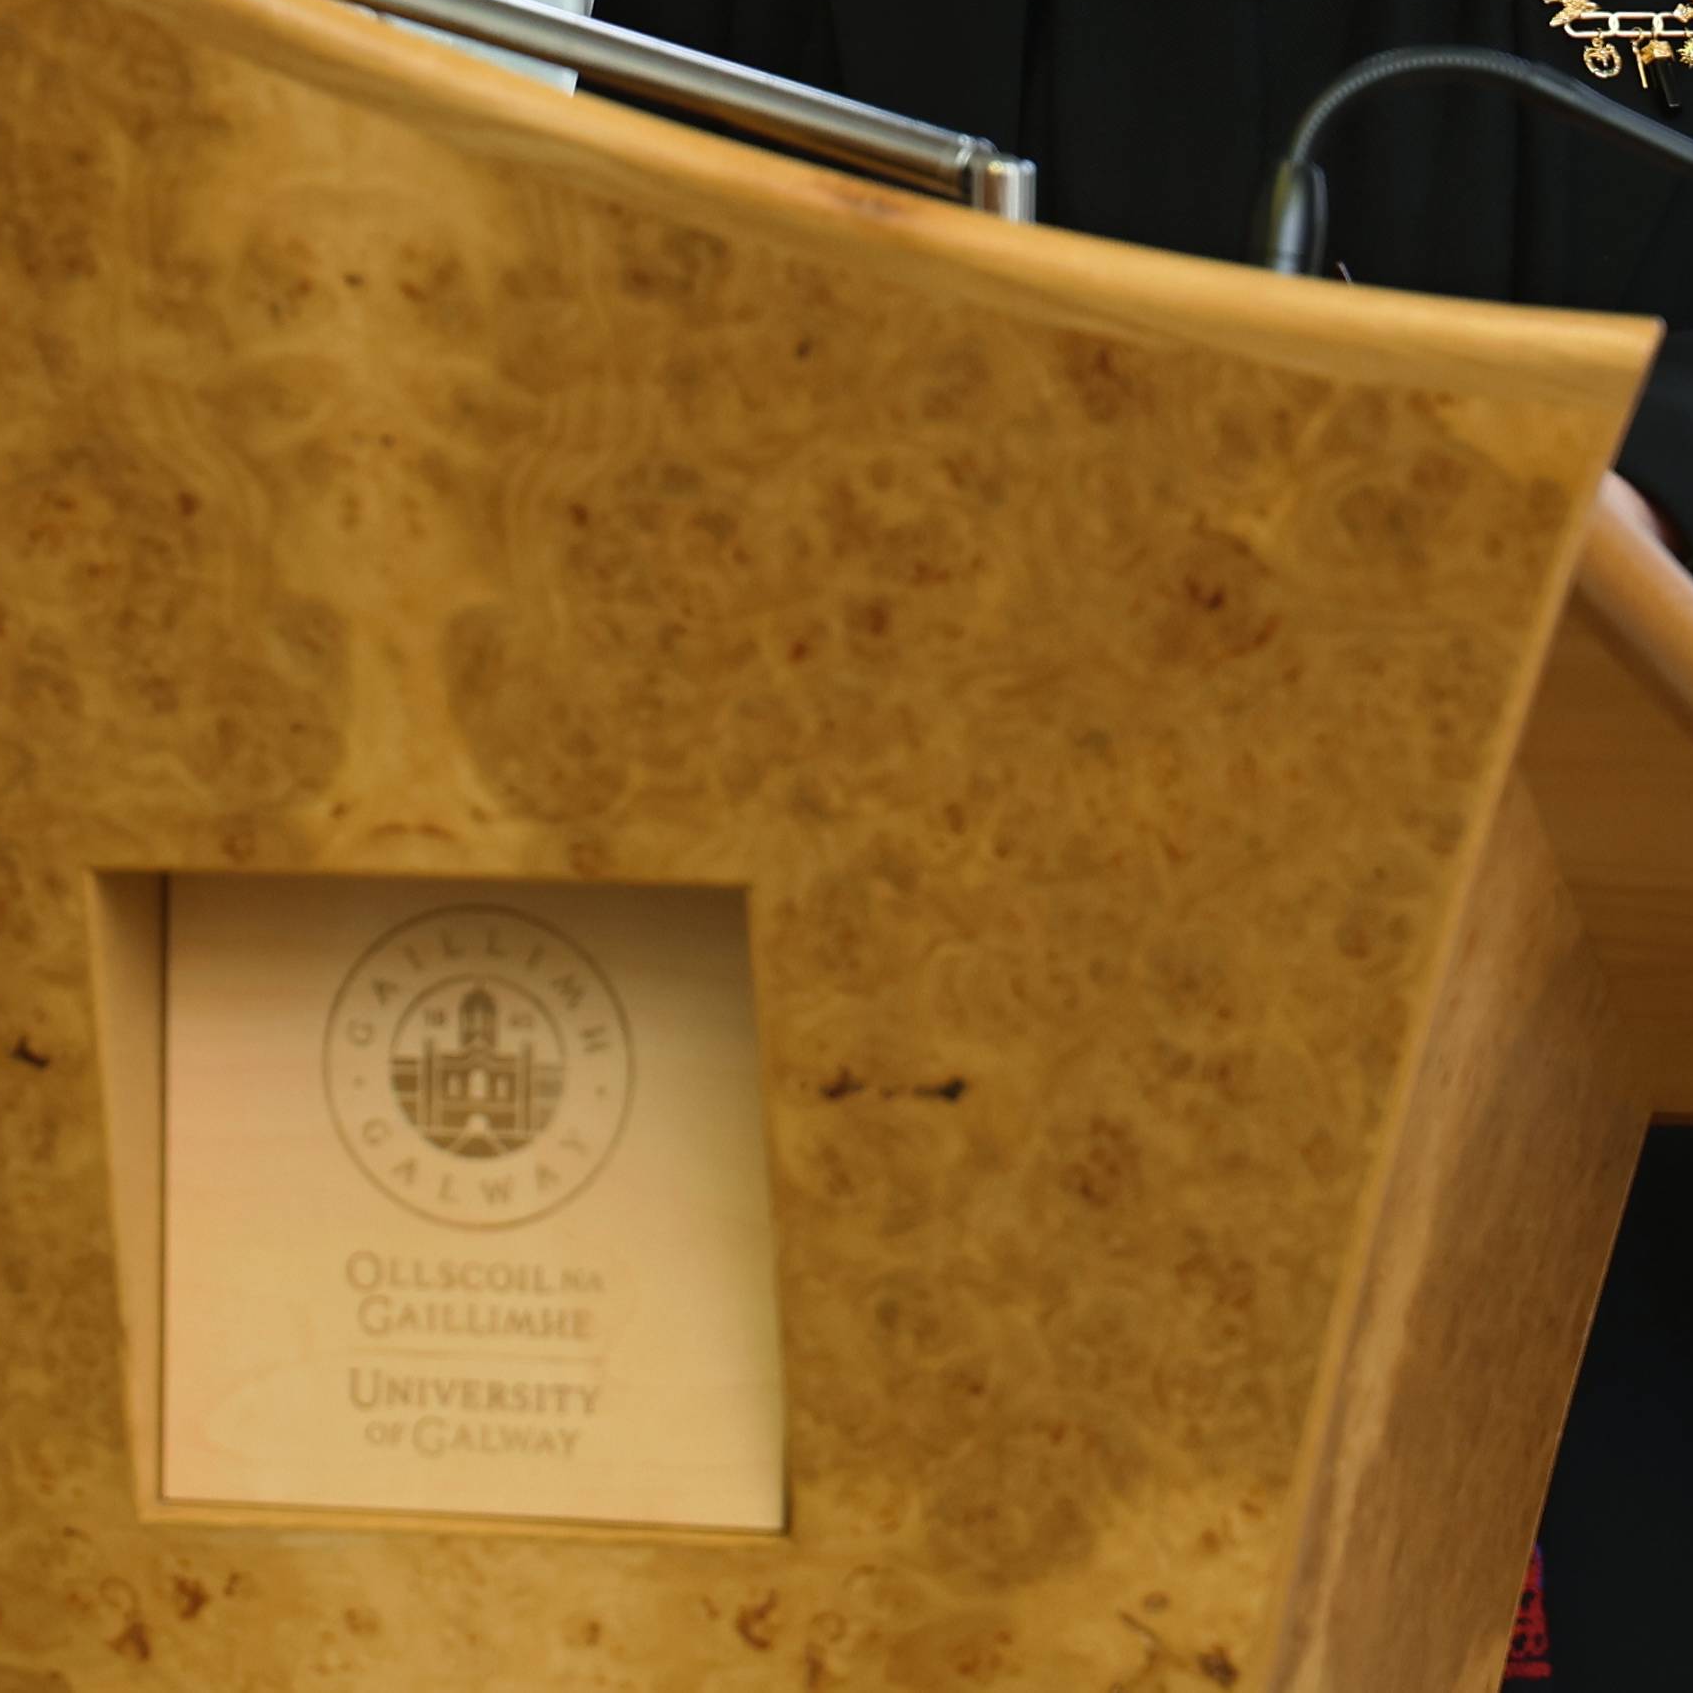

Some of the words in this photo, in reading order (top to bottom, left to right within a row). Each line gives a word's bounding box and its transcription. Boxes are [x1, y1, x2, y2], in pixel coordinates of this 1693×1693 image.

[345, 927, 609, 1054] GAILLIMH
[362, 1117, 590, 1206] GALWAY
[345, 1250, 553, 1296] OLLSCOIL
[358, 1293, 594, 1340] GAILLIMHE
[348, 1367, 601, 1415] UNIVERSITY
[412, 1415, 580, 1460] GALWAY
